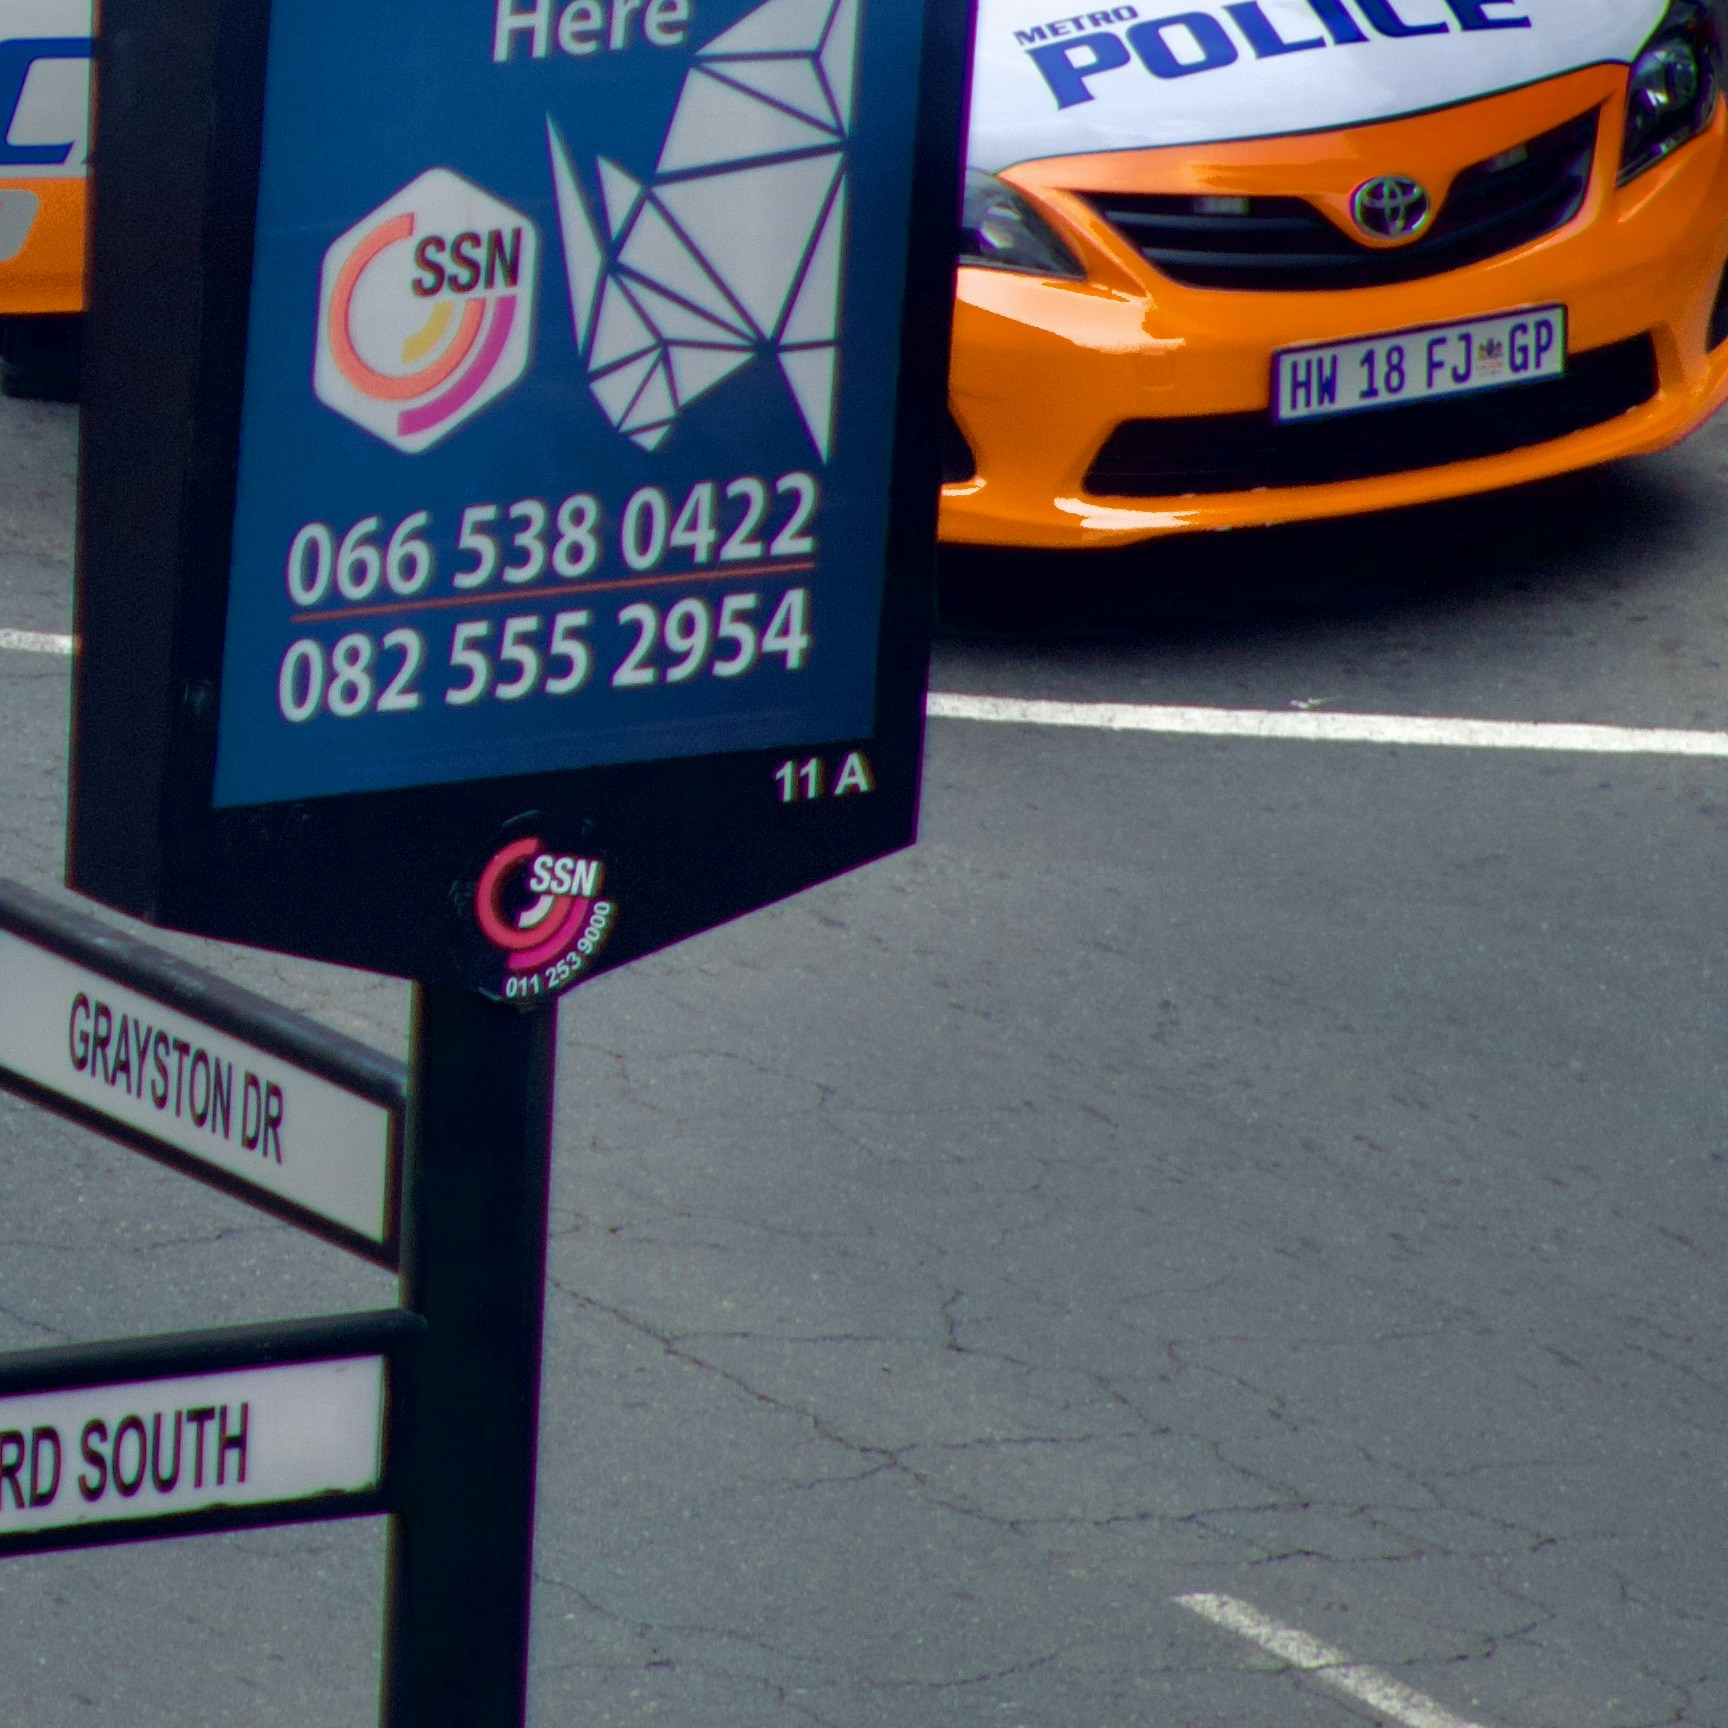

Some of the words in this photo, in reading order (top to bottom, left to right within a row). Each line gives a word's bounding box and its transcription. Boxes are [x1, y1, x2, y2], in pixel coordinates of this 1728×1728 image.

[1013, 4, 1139, 47] METRO
[411, 228, 521, 298] SSN
[1290, 353, 1338, 410] HW
[1359, 345, 1405, 399] 18
[1426, 332, 1472, 389] FJ
[1508, 318, 1553, 373] GP
[287, 511, 432, 608] 066
[453, 495, 601, 591] 538
[621, 473, 820, 571] 0422
[279, 631, 420, 724] 082
[445, 610, 589, 706] 555
[611, 589, 809, 688] 2954
[775, 759, 819, 802] 11
[836, 753, 872, 795] A
[530, 855, 599, 896] SSN
[506, 973, 541, 998] 011
[546, 951, 583, 988] 253
[577, 901, 611, 955] 9000
[69, 992, 231, 1141] GRAYSTON
[242, 1073, 284, 1164] DR
[78, 1403, 250, 1502] SOUTH
